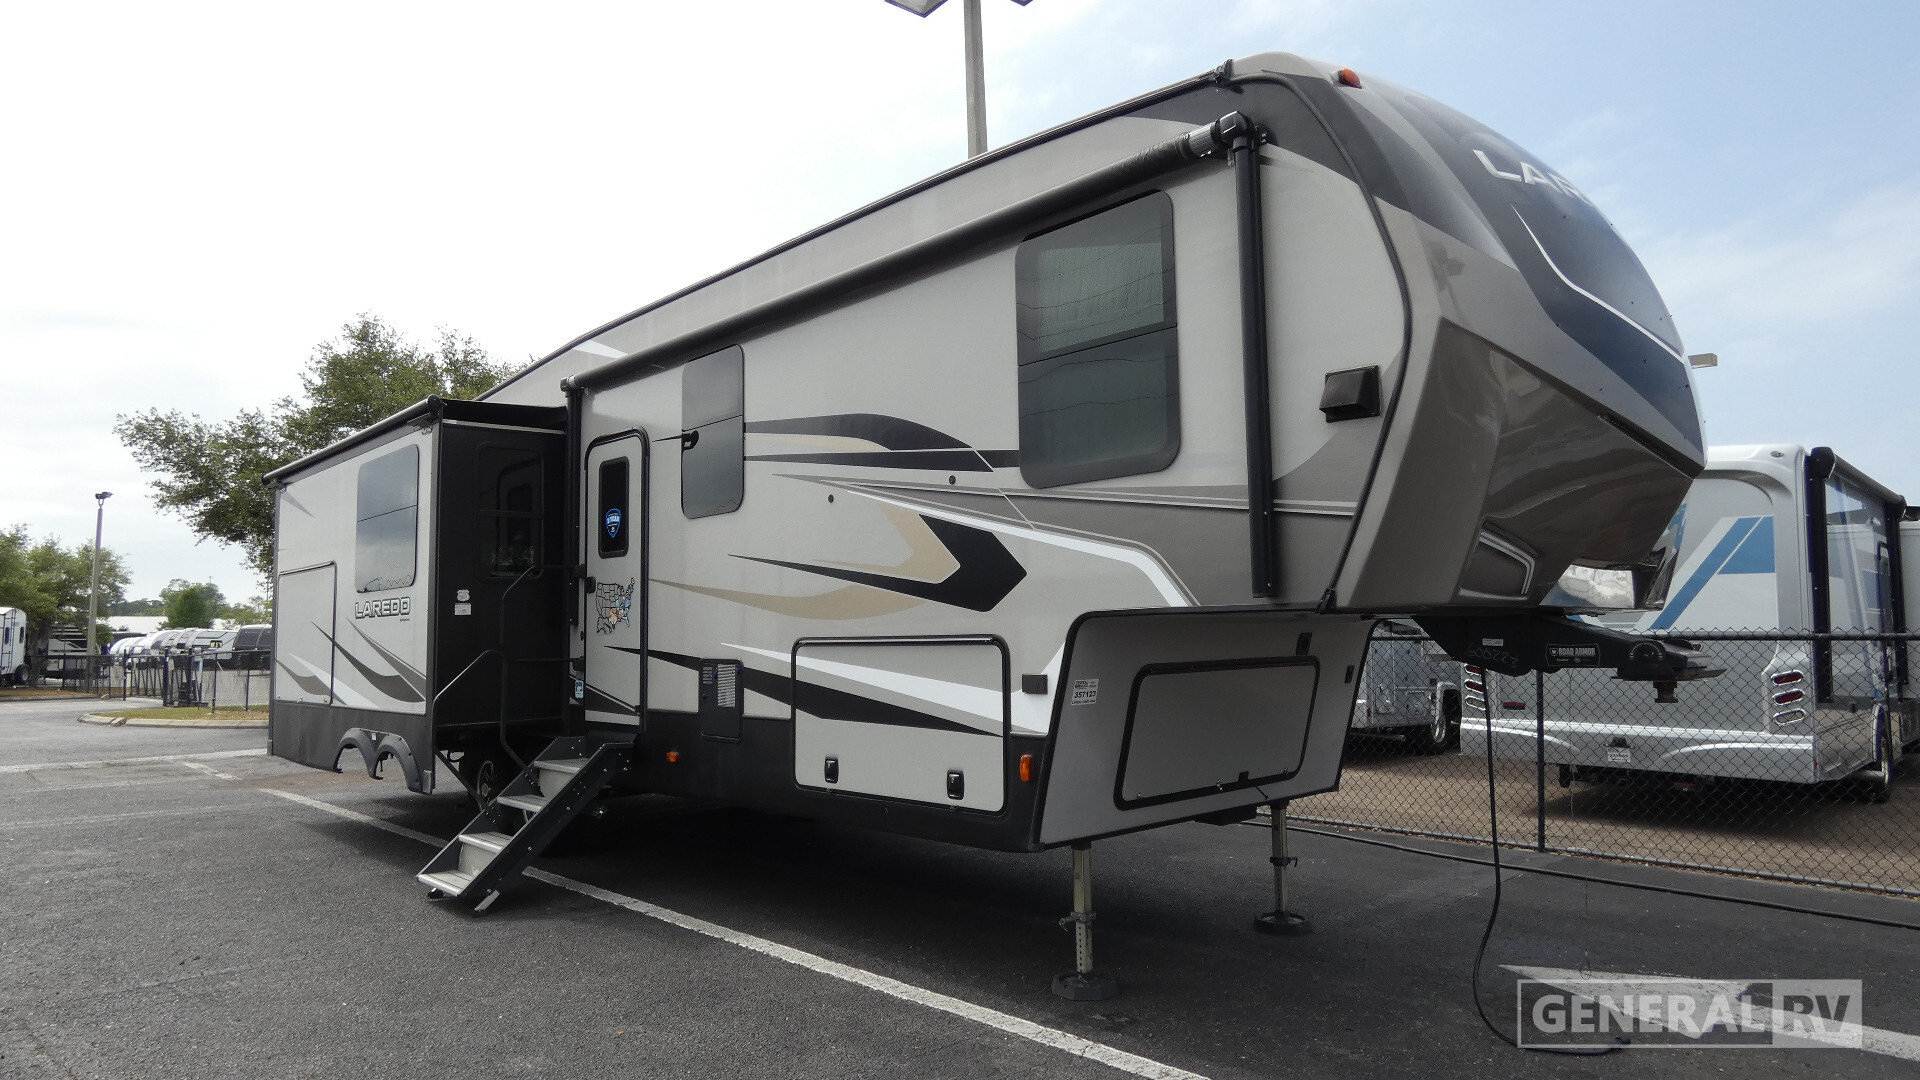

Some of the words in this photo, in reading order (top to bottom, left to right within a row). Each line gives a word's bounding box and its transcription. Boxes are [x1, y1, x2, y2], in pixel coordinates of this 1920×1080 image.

[355, 597, 411, 619] LAREDO
[1558, 647, 1575, 656] ROAD
[1575, 647, 1596, 656] ARMOR
[1074, 690, 1097, 698] 357123
